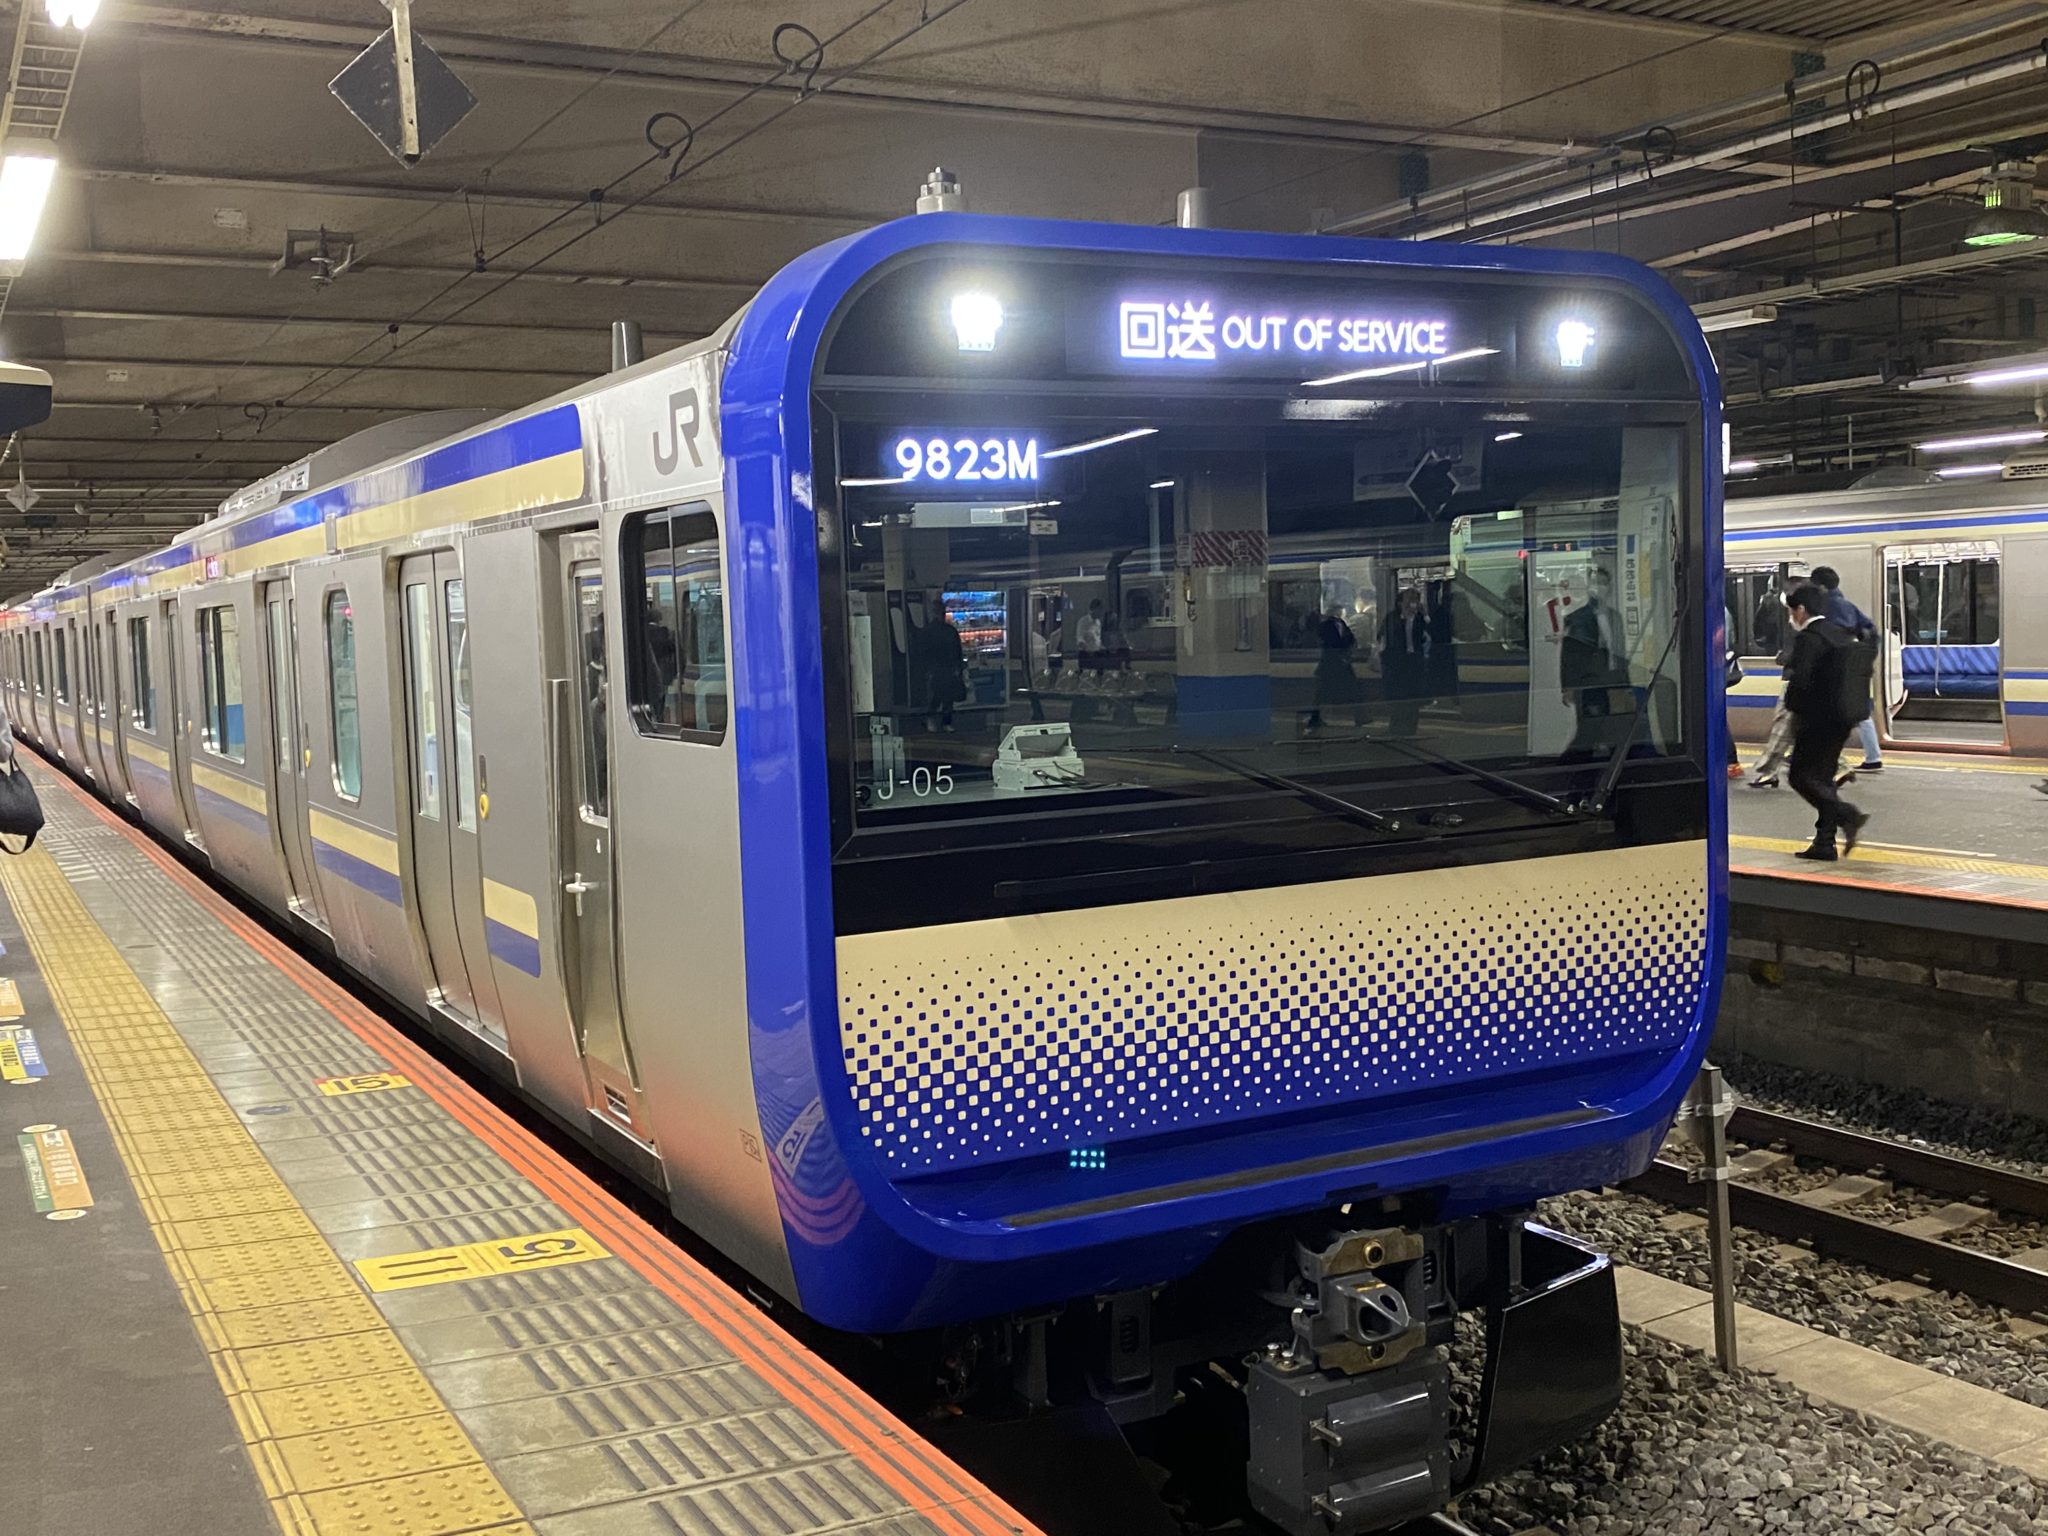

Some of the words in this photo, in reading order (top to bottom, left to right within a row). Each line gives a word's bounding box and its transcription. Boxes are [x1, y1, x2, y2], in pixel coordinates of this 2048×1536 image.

[1120, 301, 1216, 360] 回送
[1221, 315, 1288, 351] OUT
[1293, 318, 1333, 352] OF
[1338, 319, 1447, 356] SERVICE
[652, 387, 704, 476] JR
[895, 439, 1038, 481] 9823M
[877, 765, 954, 800] J-05
[332, 1075, 390, 1092] 15
